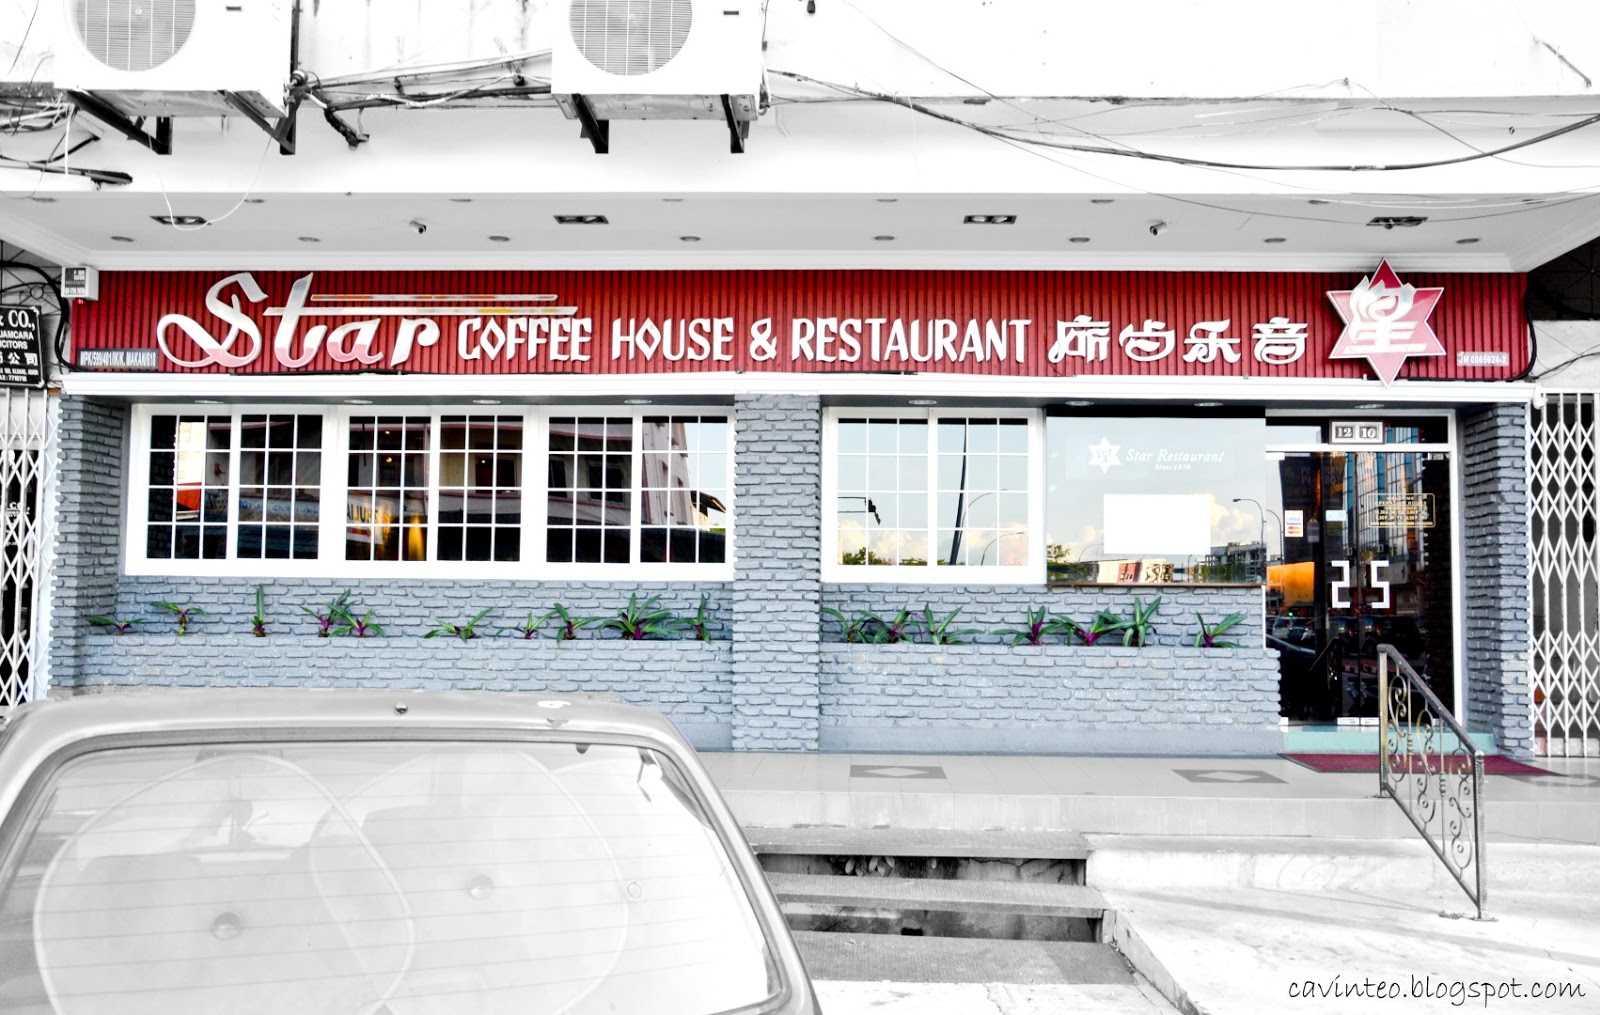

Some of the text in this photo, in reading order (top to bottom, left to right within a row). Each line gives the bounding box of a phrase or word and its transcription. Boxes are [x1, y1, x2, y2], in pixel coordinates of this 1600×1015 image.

[8, 309, 36, 332] CO.,
[156, 271, 441, 369] Star
[458, 316, 1033, 363] COFFEE HOUSE & RESTAURANT
[1335, 426, 1378, 440] 12 10
[1126, 448, 1225, 463] Star Restaurant
